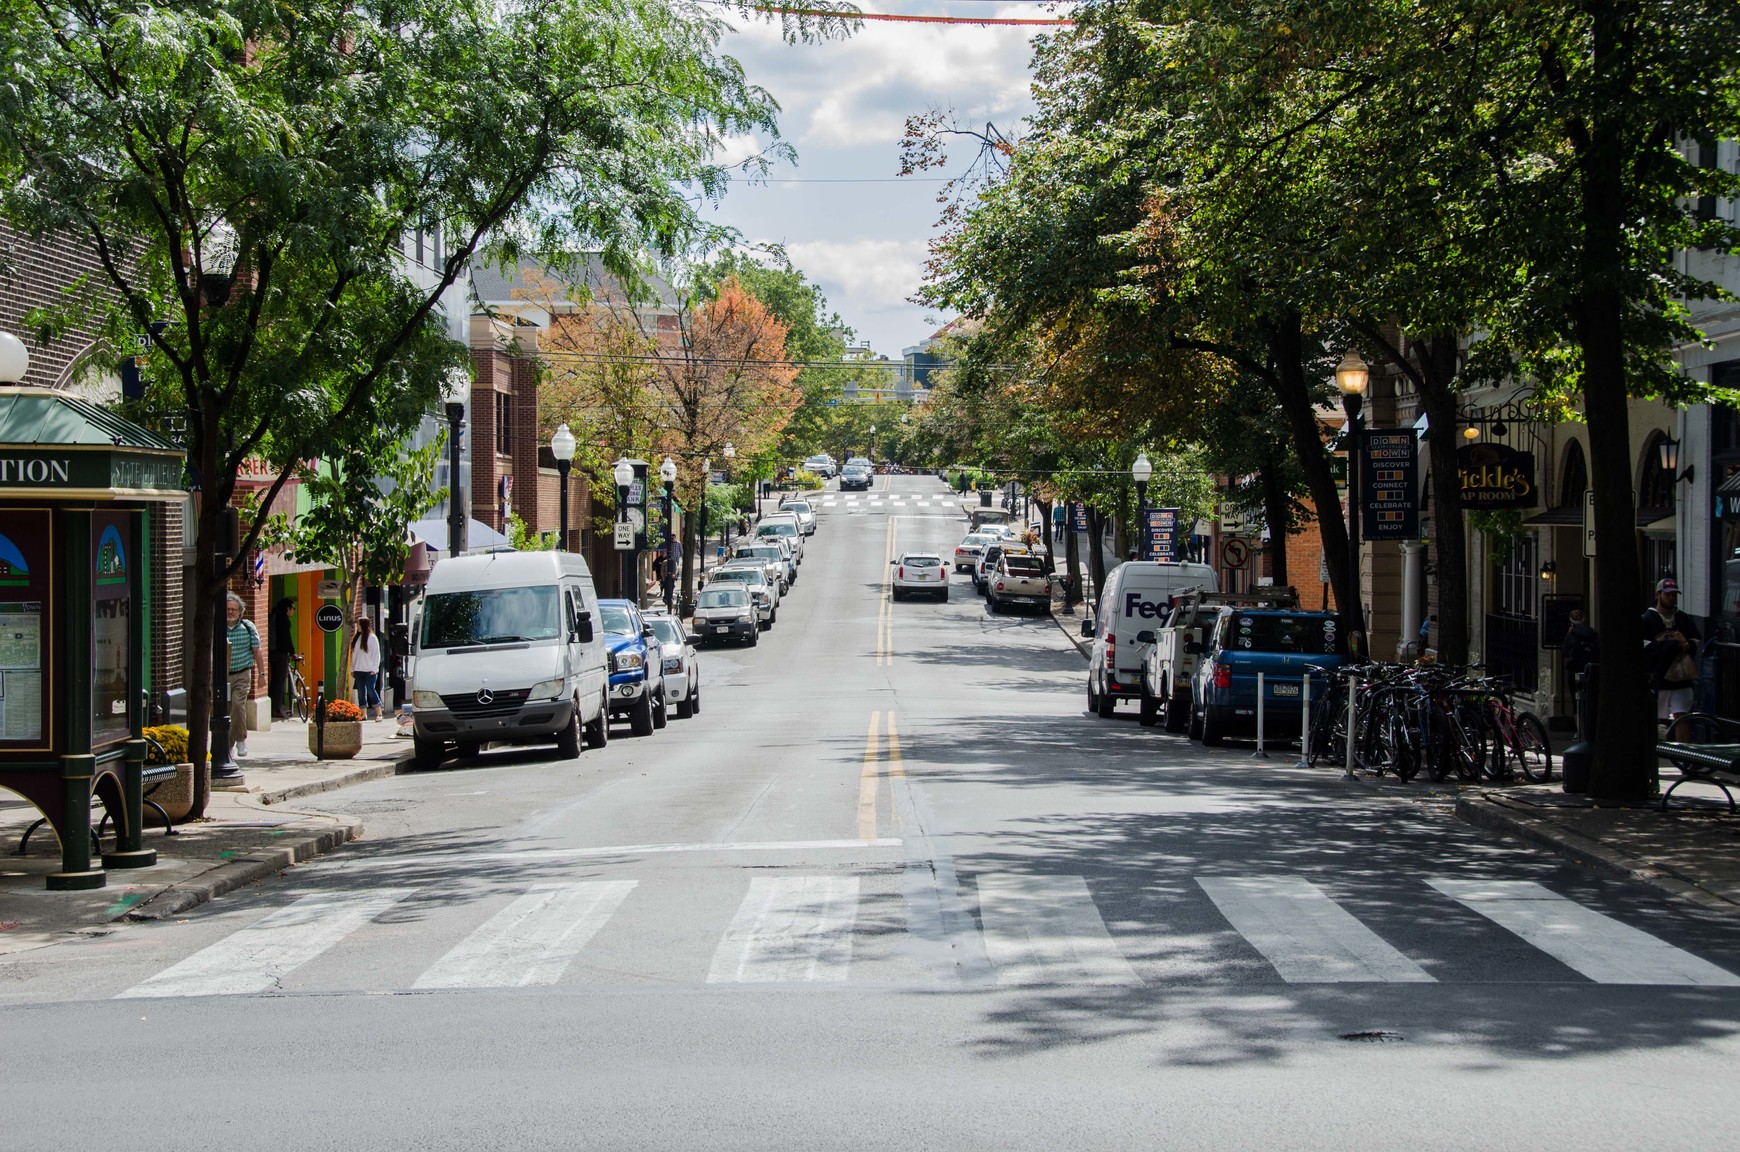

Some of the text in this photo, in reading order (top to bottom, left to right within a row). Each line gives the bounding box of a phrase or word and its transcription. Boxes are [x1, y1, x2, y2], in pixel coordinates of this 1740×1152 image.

[0, 459, 70, 483] TION
[1460, 491, 1516, 501] AP ROOM
